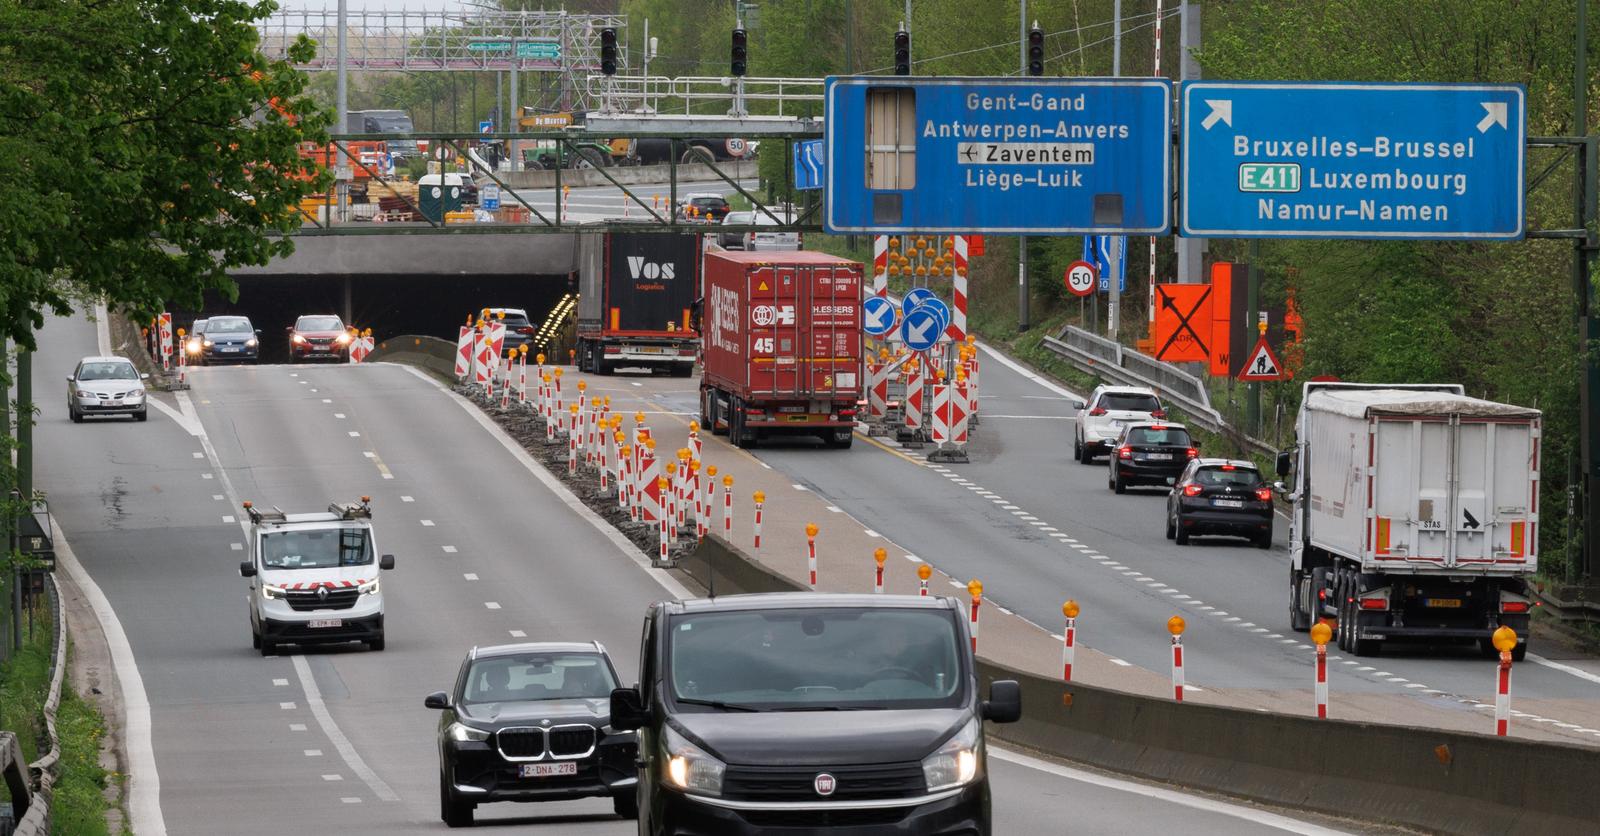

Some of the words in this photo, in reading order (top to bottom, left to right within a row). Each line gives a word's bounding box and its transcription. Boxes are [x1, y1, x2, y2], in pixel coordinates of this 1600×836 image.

[966, 93, 1085, 111] Gent-Gand
[923, 119, 1129, 141] Antwerpen-Anvers
[730, 141, 743, 150] 50
[986, 145, 1092, 162] Zaventem
[1233, 135, 1474, 158] Bruxelles-Brussel
[966, 168, 1083, 191] Liège-Luik
[1309, 168, 1467, 195] Luxembourg
[1258, 198, 1448, 220] Namur-Namen
[1072, 272, 1091, 285] 50
[813, 306, 854, 314] H.ESSERS
[754, 338, 774, 353] 45
[1423, 520, 1441, 529] STAS
[525, 763, 576, 776] 2-DNA-278
